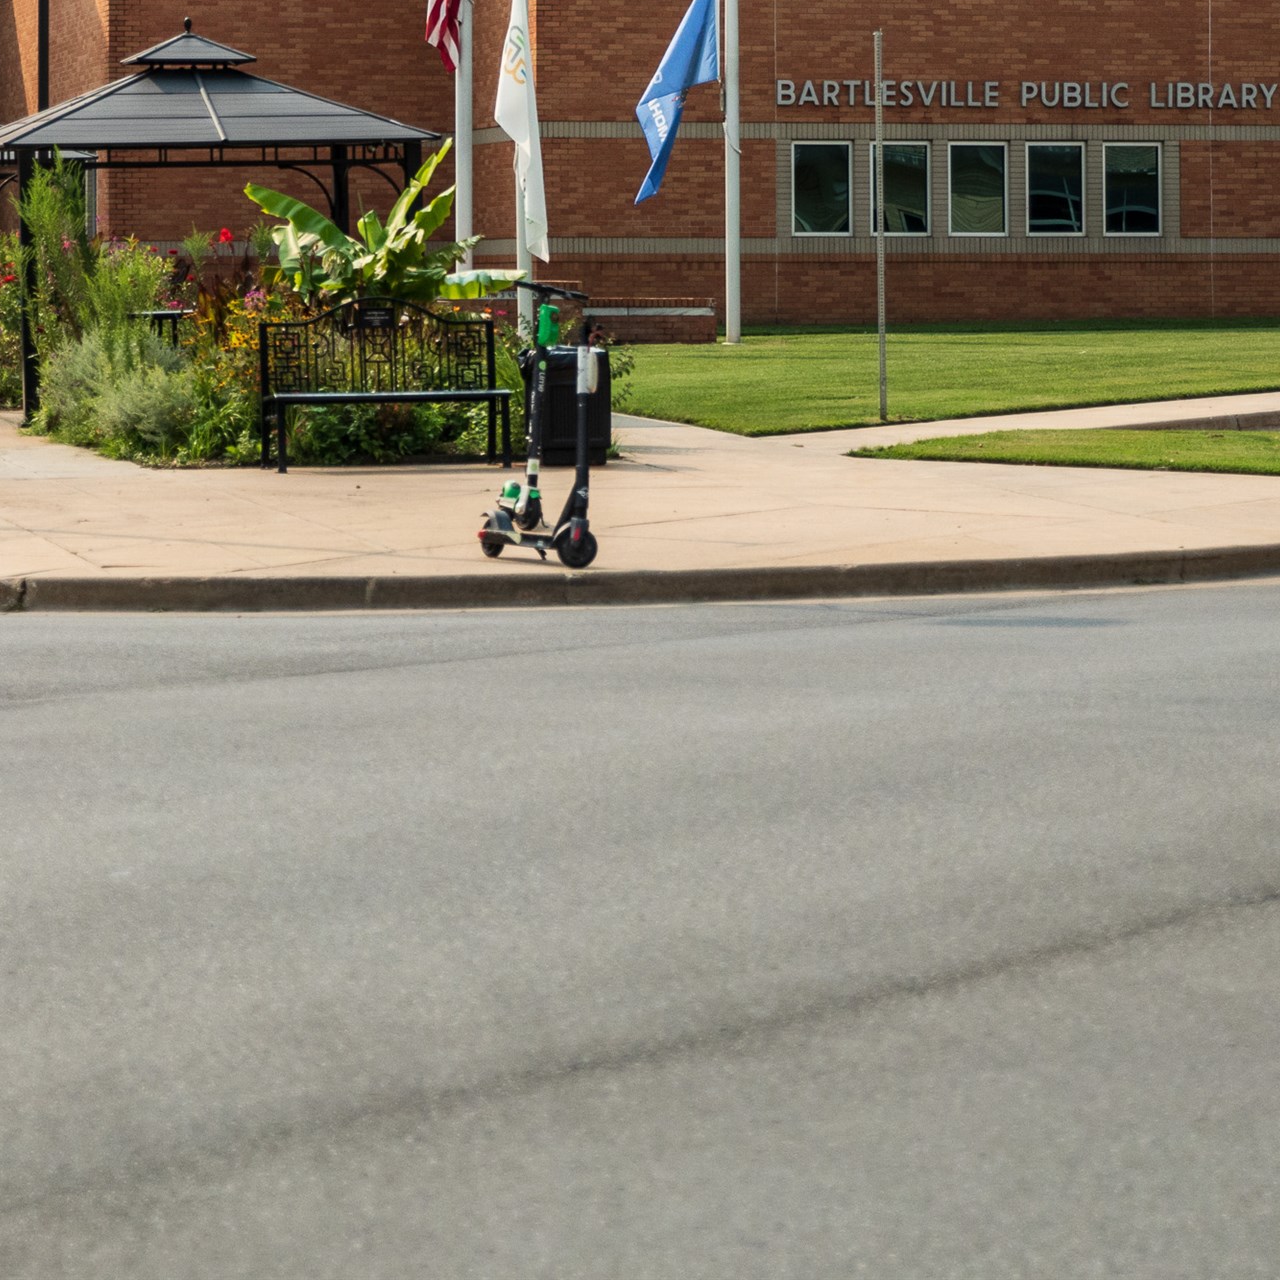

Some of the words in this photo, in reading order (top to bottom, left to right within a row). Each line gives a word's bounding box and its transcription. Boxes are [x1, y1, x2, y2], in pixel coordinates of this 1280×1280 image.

[775, 78, 1000, 108] BARTLESVILLE
[1021, 81, 1130, 109] PUBLIC
[1149, 82, 1279, 110] LIBRARY
